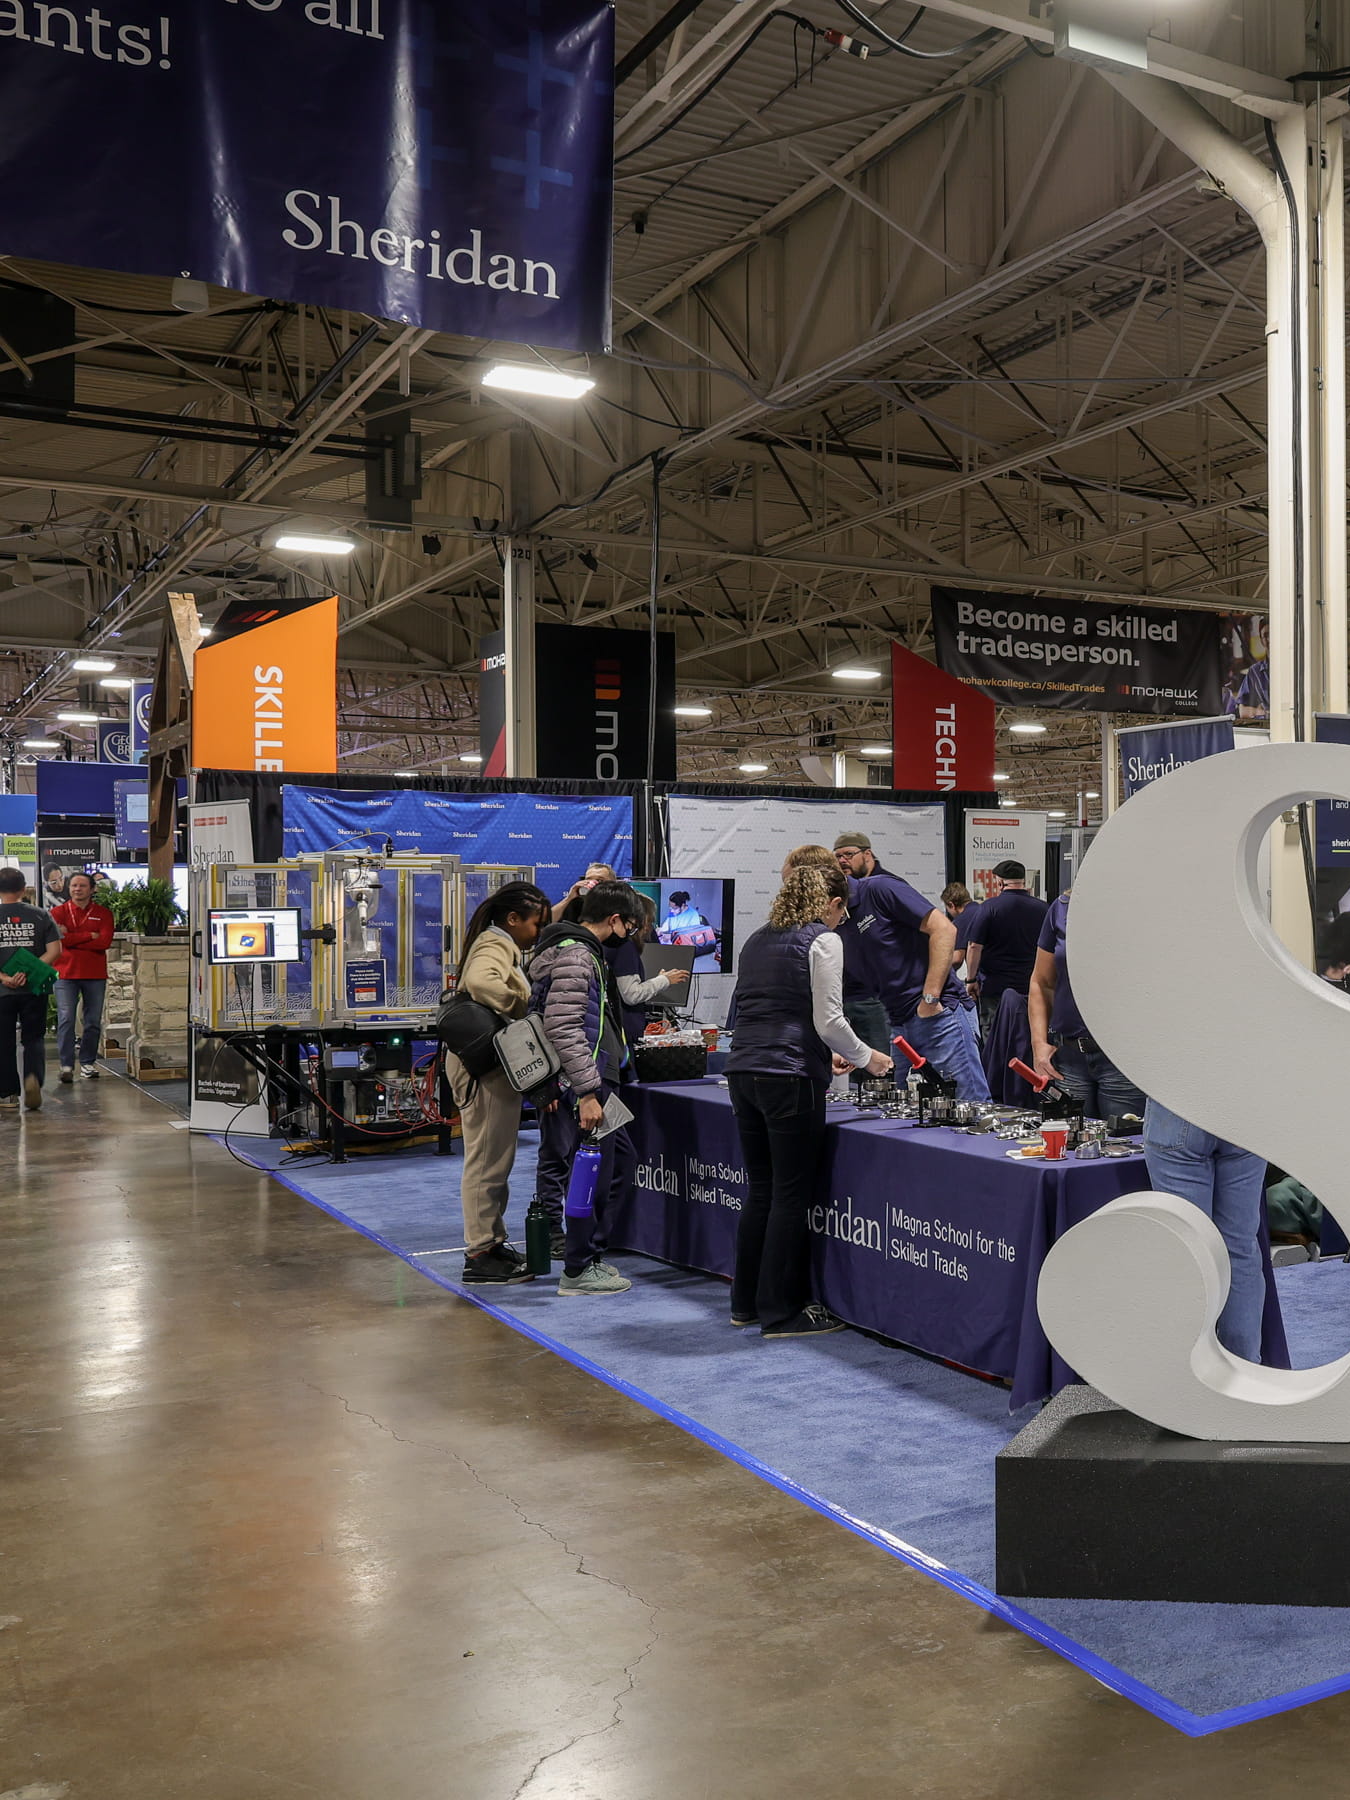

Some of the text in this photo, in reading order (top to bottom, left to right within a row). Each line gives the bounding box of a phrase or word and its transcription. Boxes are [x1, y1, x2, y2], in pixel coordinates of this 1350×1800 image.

[281, 189, 560, 300] Sheridan
[957, 602, 1178, 643] Become a skilled
[957, 630, 1140, 668] tradesperson.
[1128, 753, 1191, 782] Sherid
[972, 836, 1015, 849] Sheridan
[515, 1058, 544, 1079] ROOTS
[632, 1154, 680, 1196] eridan
[807, 1197, 1016, 1262] eridan Magna School for the
[890, 1238, 969, 1282] Skilled Trades
